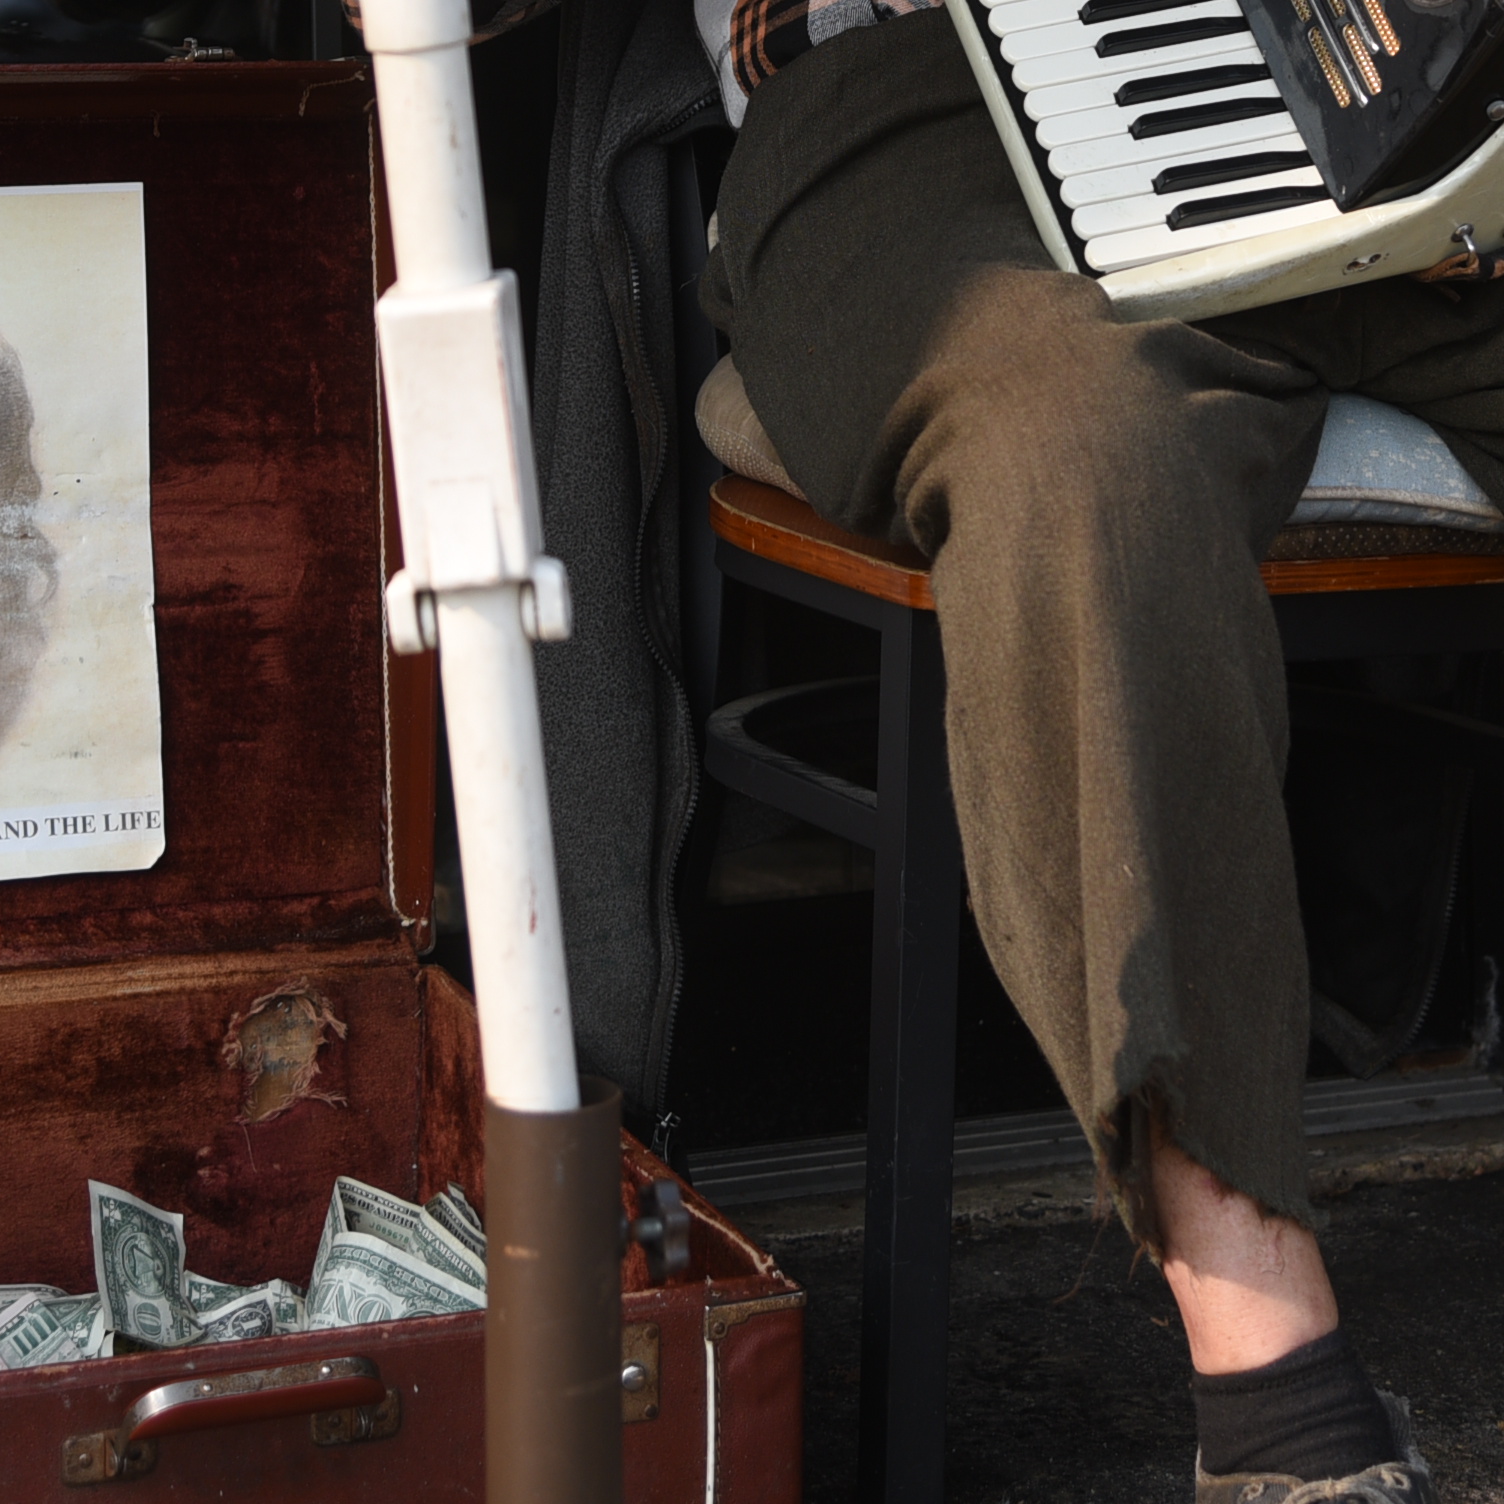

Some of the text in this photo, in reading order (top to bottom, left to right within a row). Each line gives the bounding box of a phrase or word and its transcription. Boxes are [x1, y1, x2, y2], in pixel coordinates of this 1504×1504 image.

[44, 814, 97, 838] THE
[102, 810, 161, 833] LIFE
[431, 1236, 475, 1279] AMERICA
